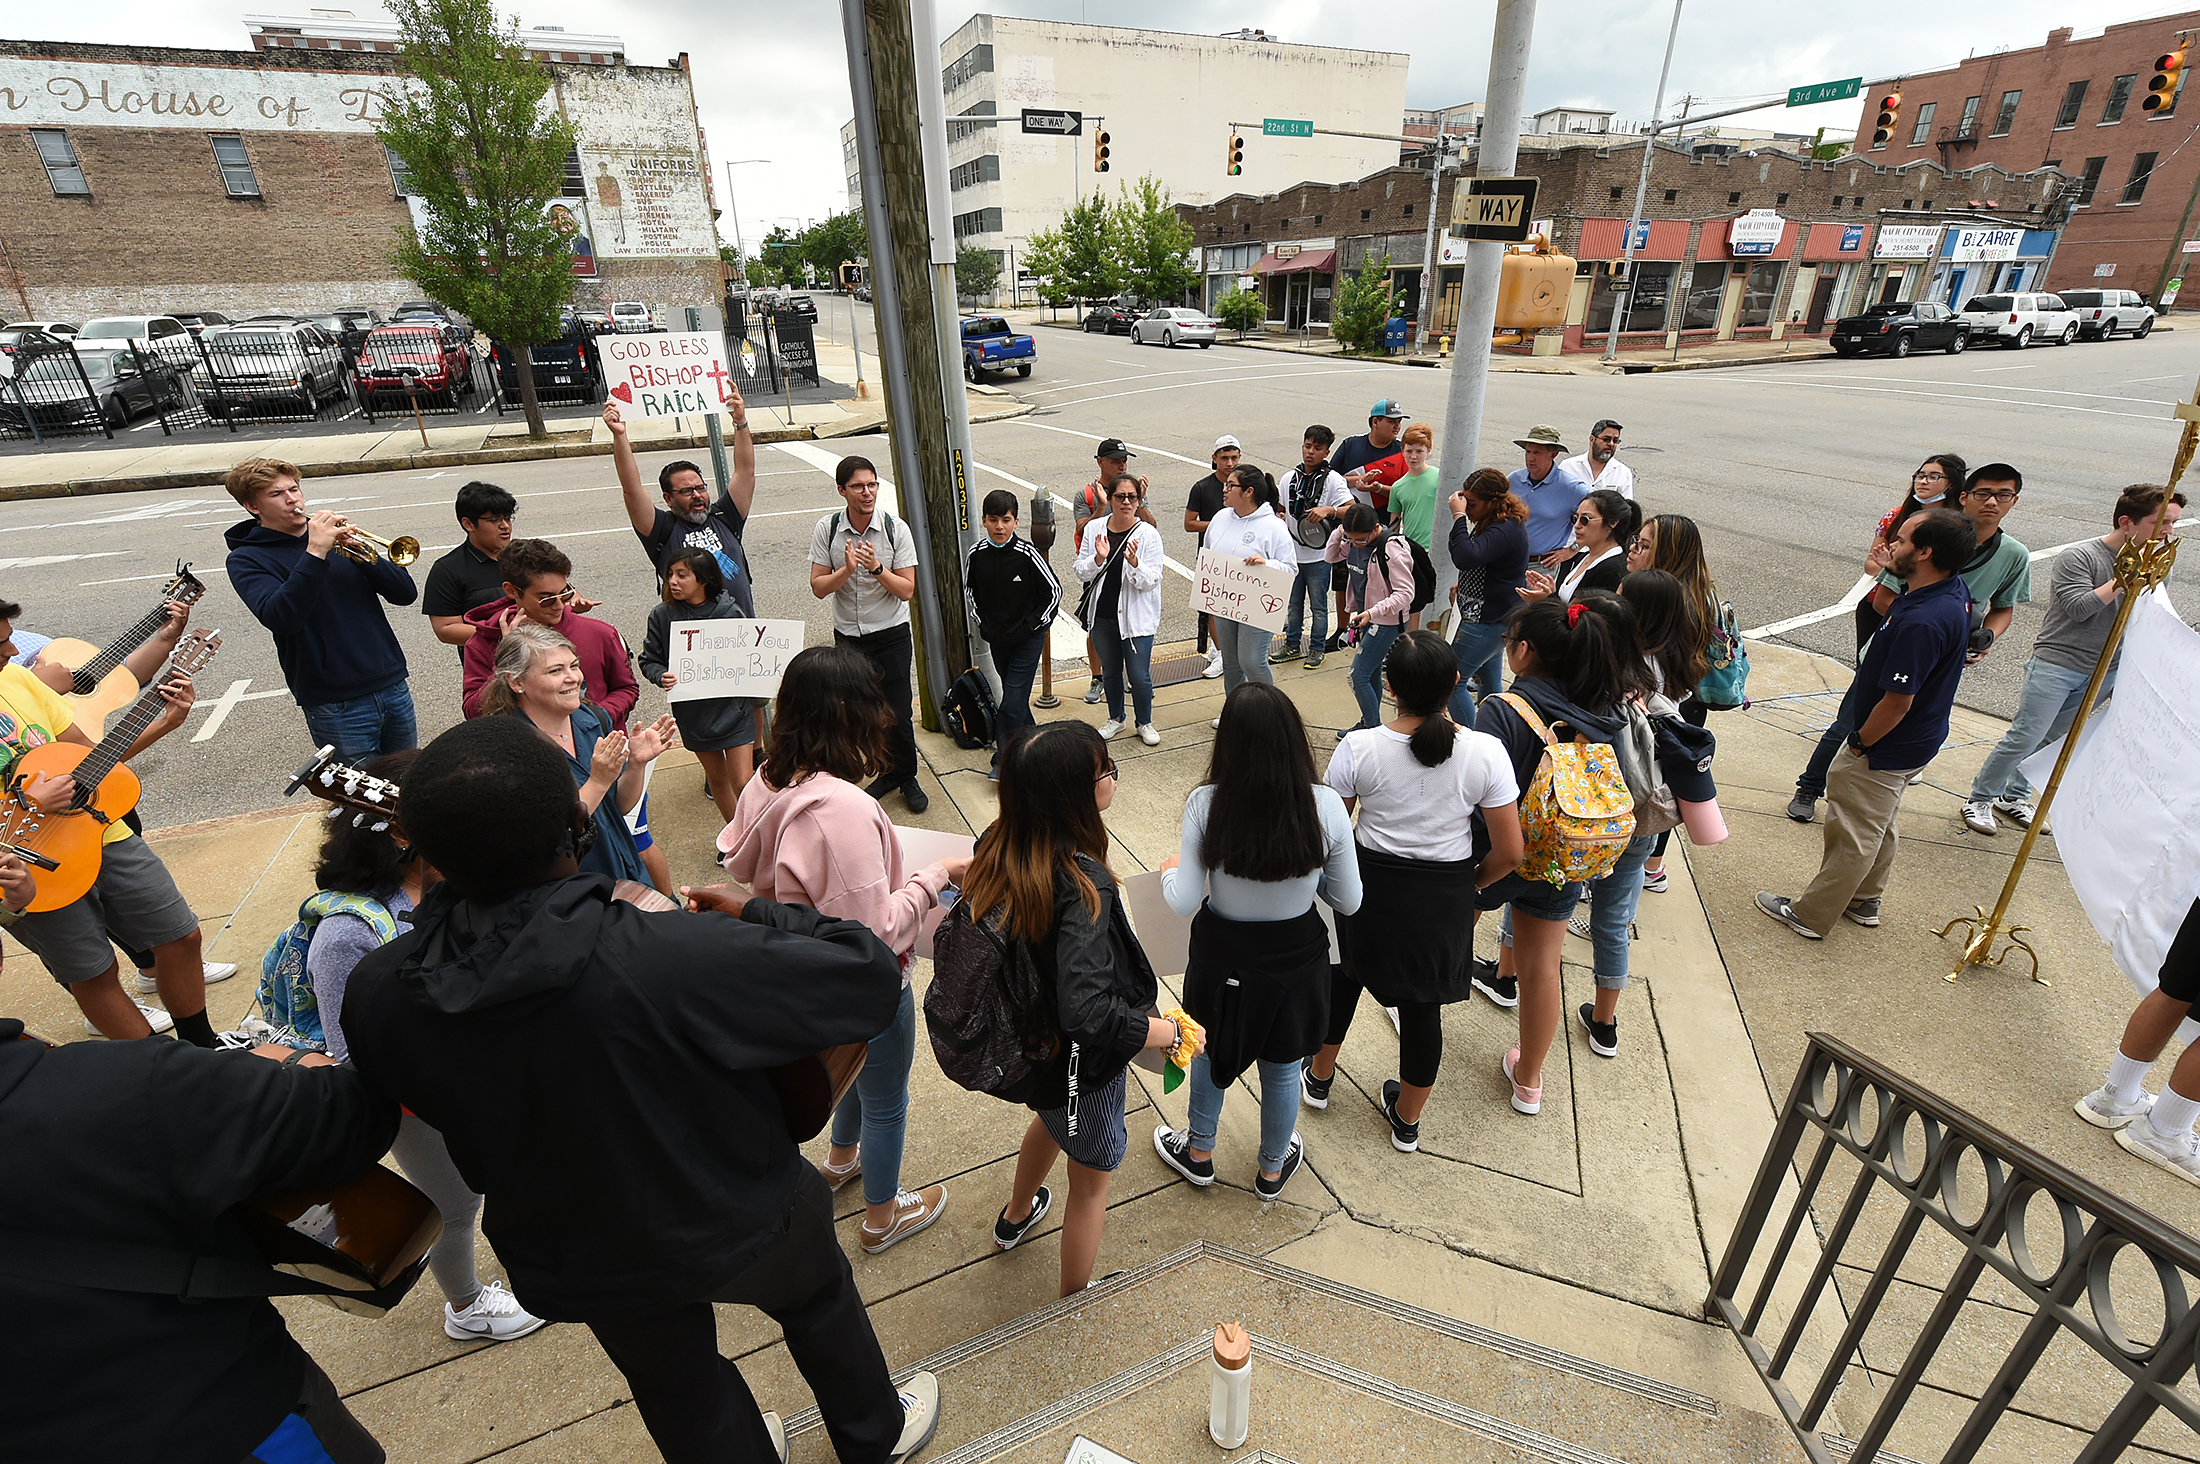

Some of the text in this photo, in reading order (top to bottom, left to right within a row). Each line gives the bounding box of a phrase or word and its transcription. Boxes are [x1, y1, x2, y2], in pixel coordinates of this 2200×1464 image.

[46, 76, 235, 117] House
[257, 96, 310, 127] of
[1794, 83, 1854, 102] 3rd Ave N
[1029, 117, 1065, 128] ONE WAY
[1267, 122, 1310, 133] 22nd St N
[630, 159, 696, 170] UNIFORMS
[1479, 198, 1521, 222] WAY
[609, 337, 709, 360] GOD BLESS
[780, 341, 806, 352] CATHOLIC
[802, 350, 809, 359] OF
[955, 449, 968, 530] A20375
[684, 526, 713, 542] JESUS
[687, 532, 719, 549] TRUST
[707, 540, 724, 554] OU
[1200, 555, 1270, 588] Welcome
[1200, 577, 1246, 607] Bishop
[1204, 596, 1250, 622] Raica
[680, 625, 790, 651] Thank You
[679, 652, 783, 685] Bishop Bak
[1068, 1073, 1079, 1097] PINK
[1068, 1113, 1078, 1137] PINK
